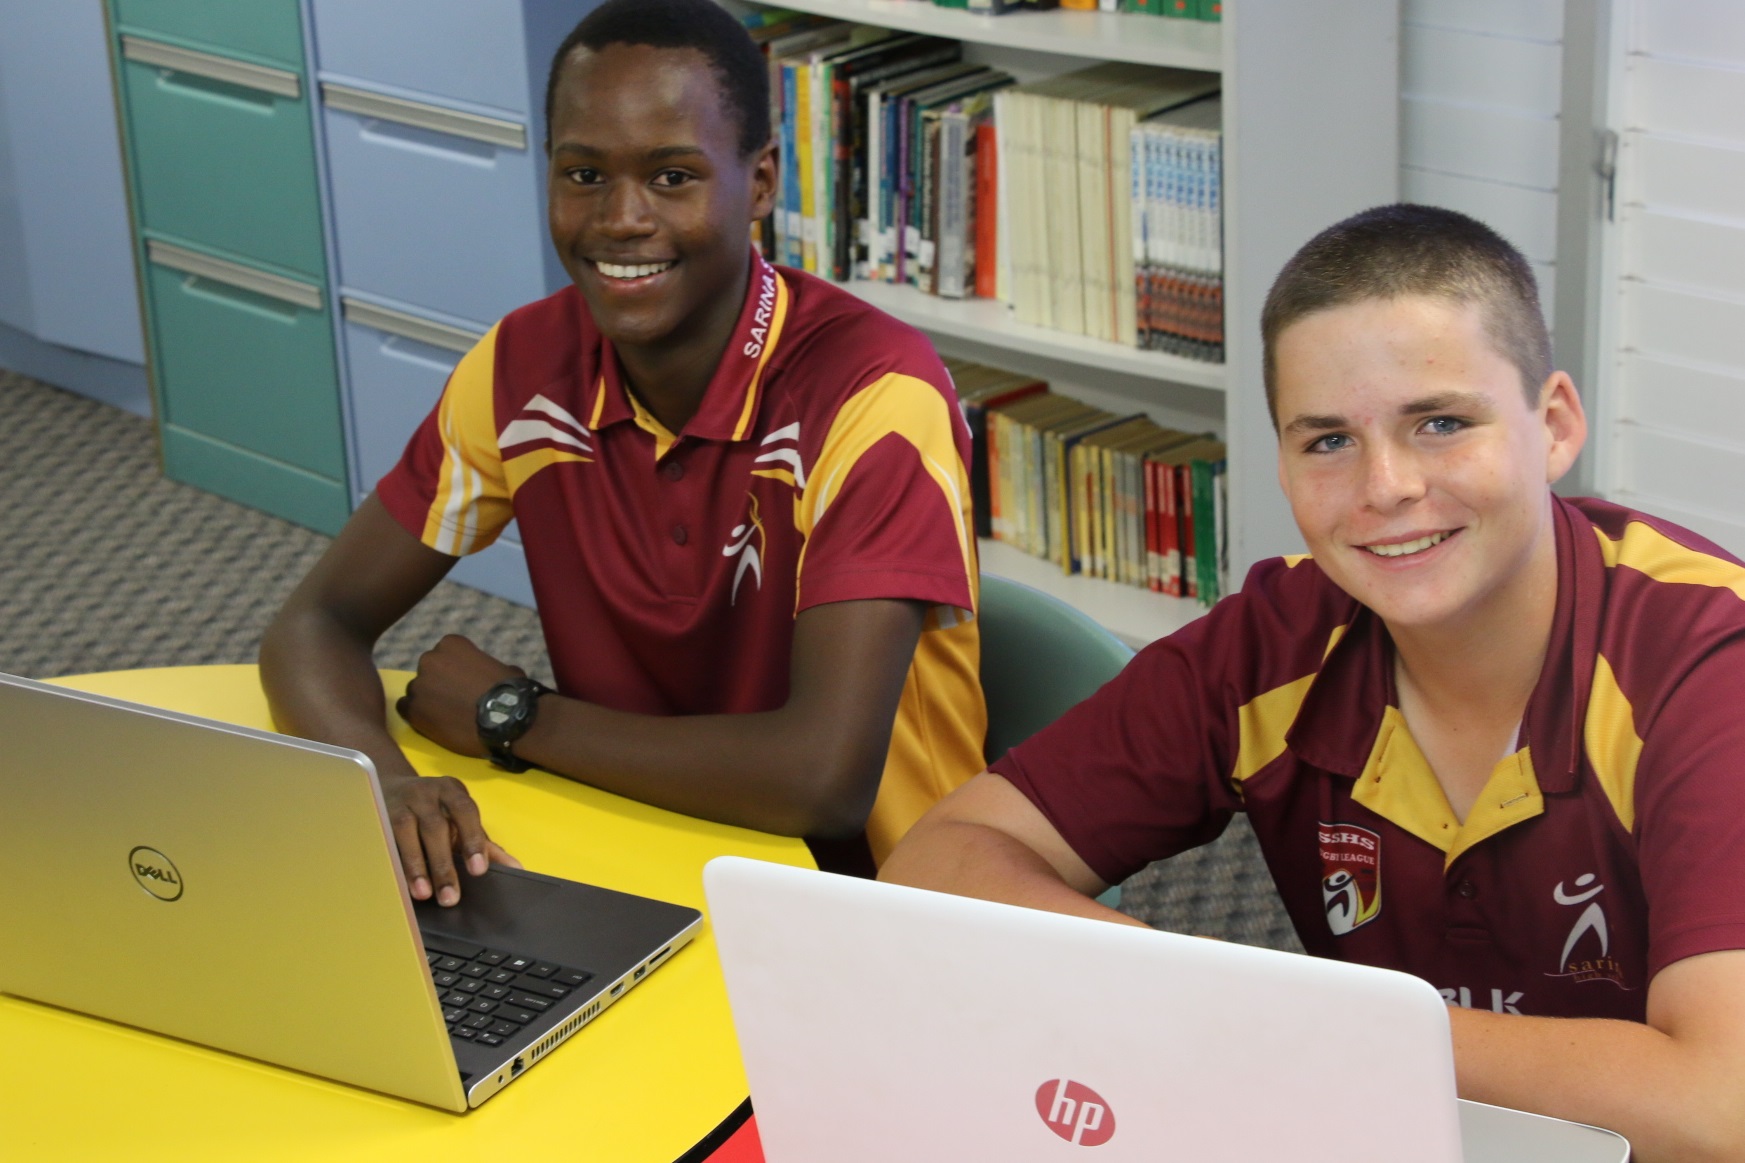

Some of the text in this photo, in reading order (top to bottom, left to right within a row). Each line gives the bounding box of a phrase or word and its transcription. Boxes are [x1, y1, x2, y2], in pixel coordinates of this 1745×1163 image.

[743, 274, 775, 358] SARINA
[1318, 831, 1375, 851] SSHS
[135, 863, 178, 885] DELL
[1047, 1079, 1105, 1145] hp
